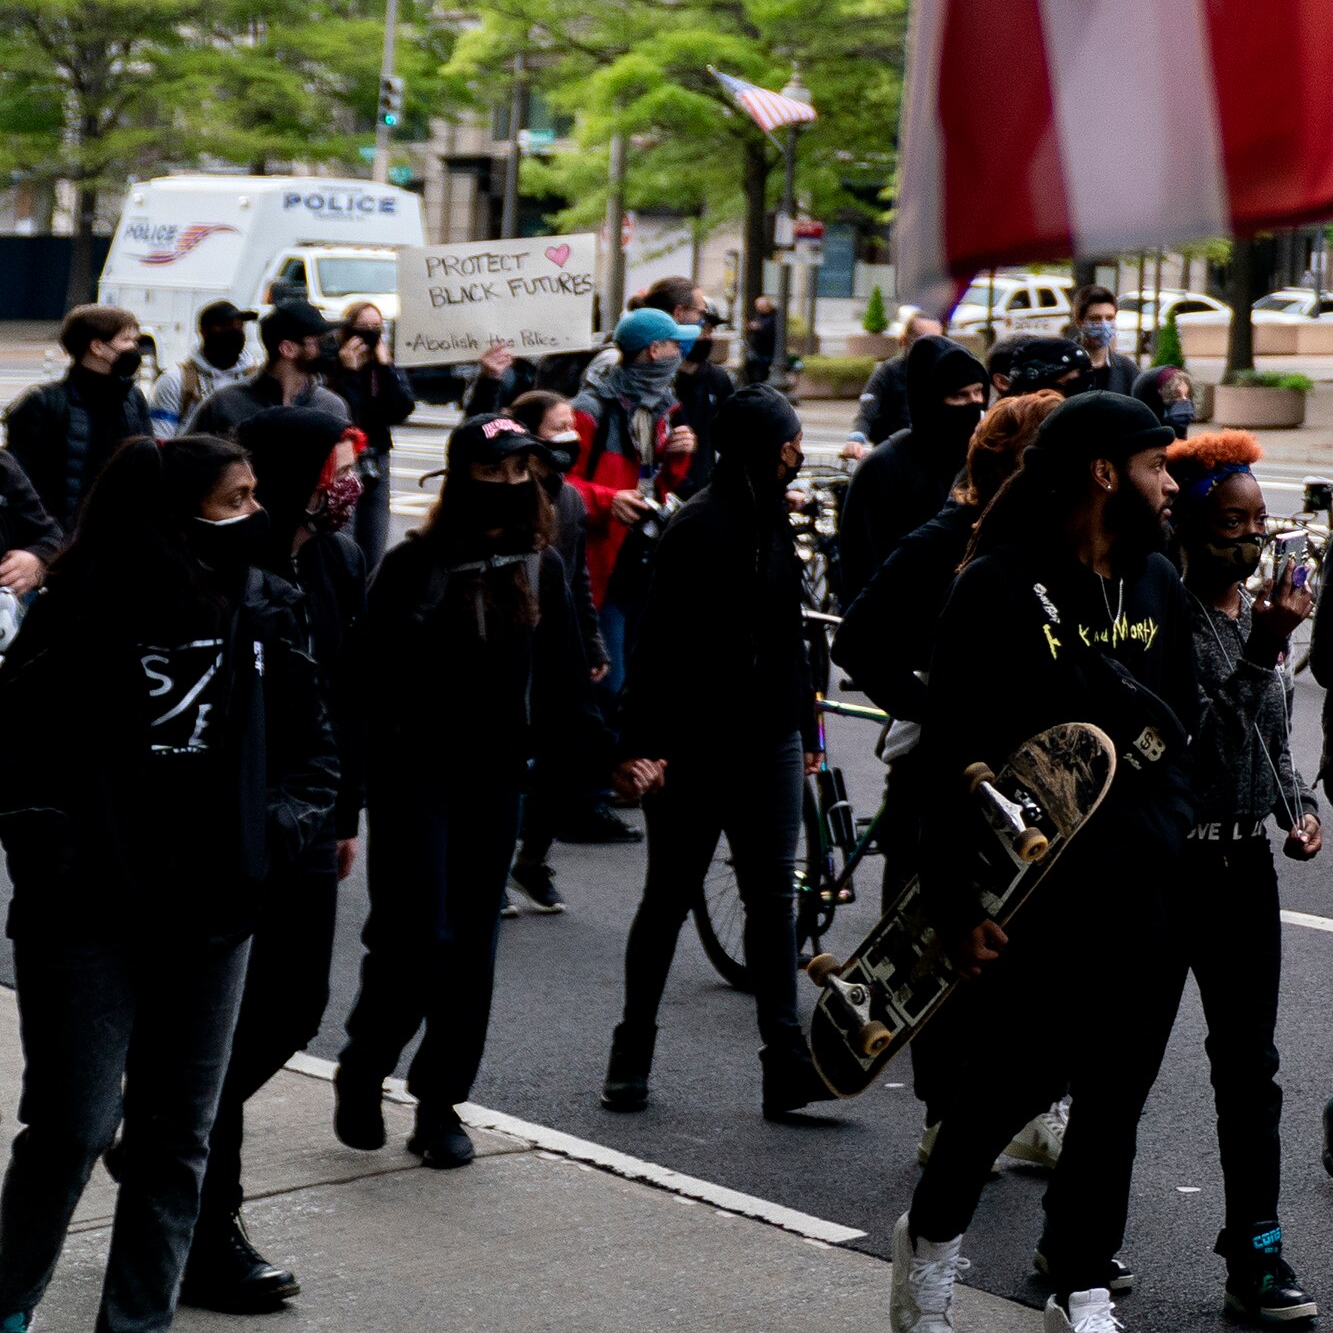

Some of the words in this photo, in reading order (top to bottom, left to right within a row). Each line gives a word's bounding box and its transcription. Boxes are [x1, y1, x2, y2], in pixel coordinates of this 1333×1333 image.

[282, 192, 397, 213] POLICE
[123, 223, 178, 242] POLICE
[425, 252, 529, 279] PROTECT
[428, 282, 499, 308] BLACK
[507, 272, 593, 297] FUTURES
